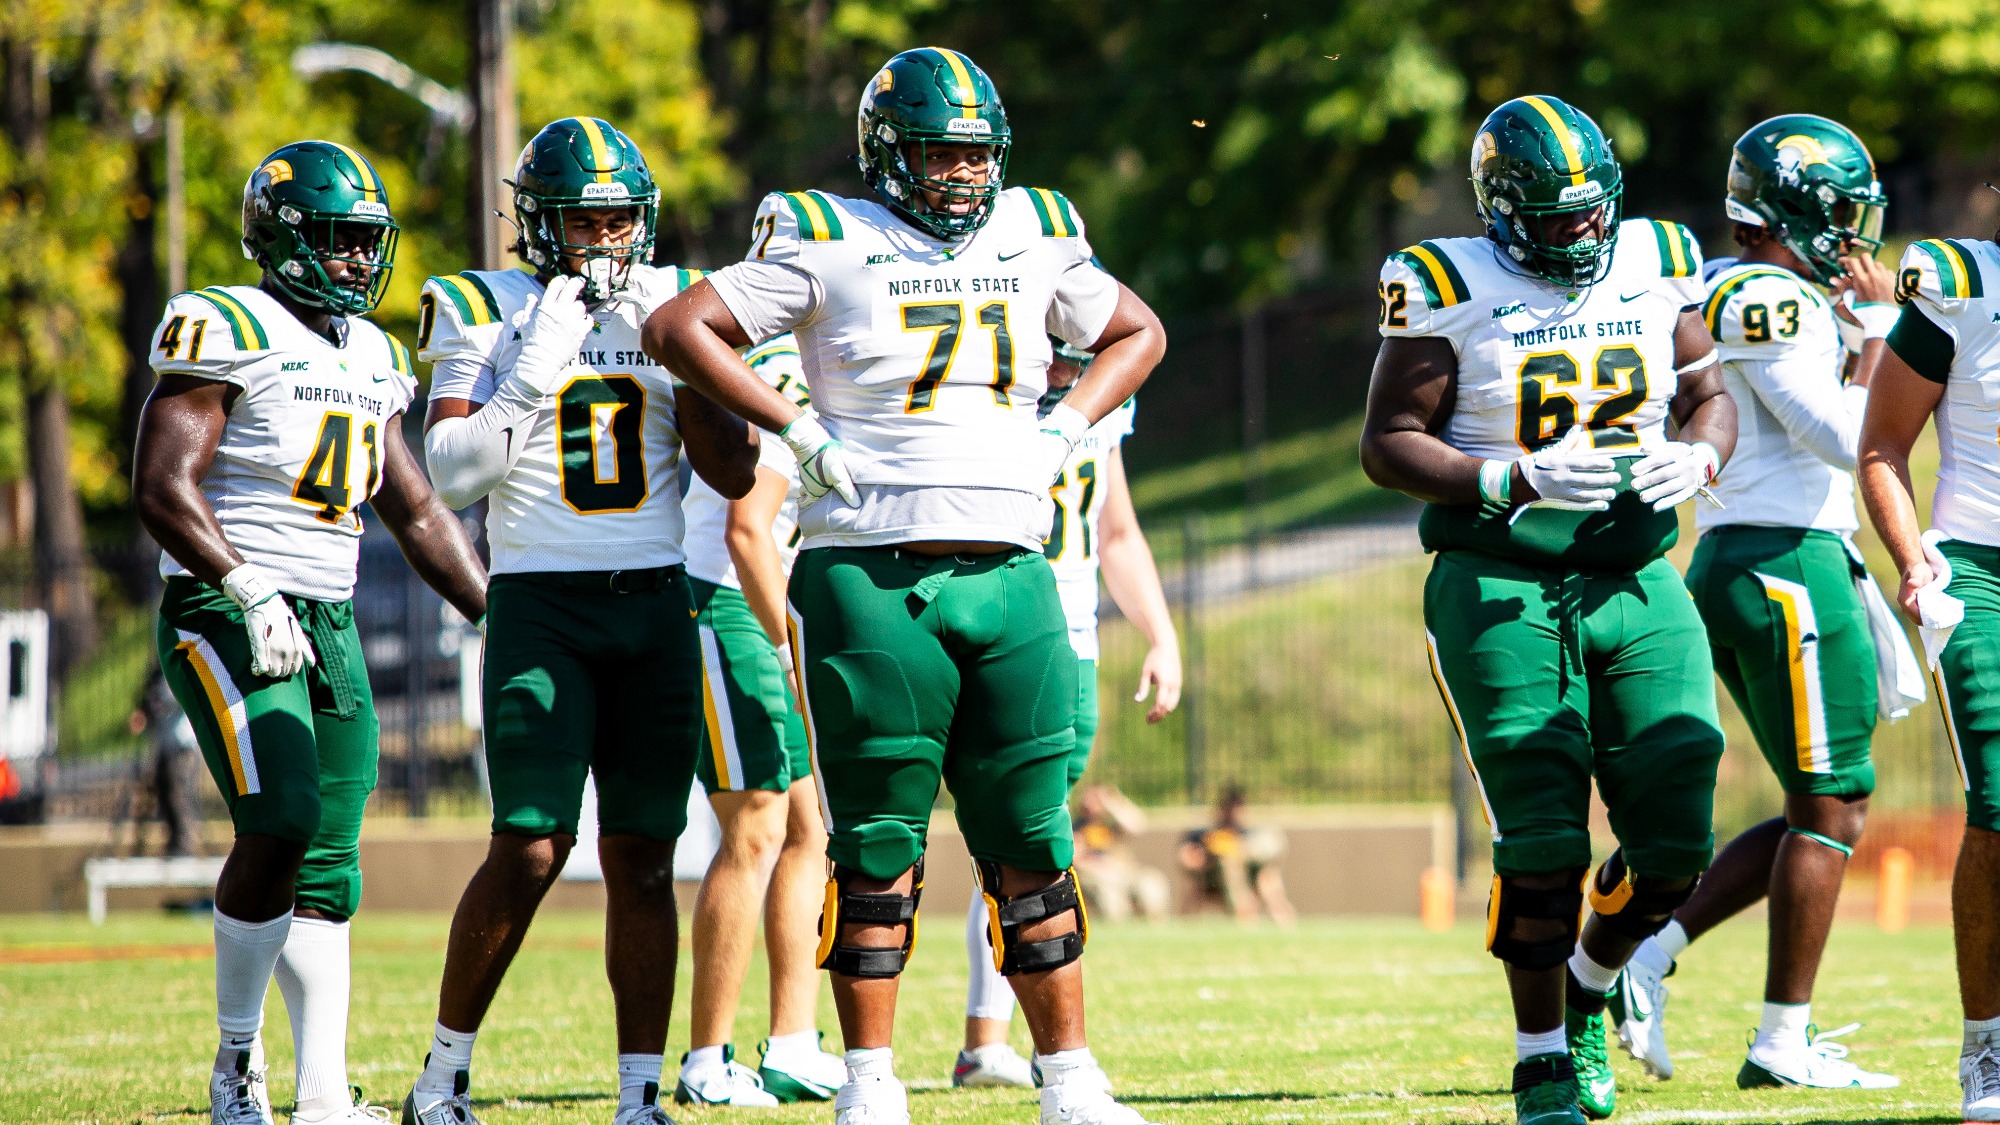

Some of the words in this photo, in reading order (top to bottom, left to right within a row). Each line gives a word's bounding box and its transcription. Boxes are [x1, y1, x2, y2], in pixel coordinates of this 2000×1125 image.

[952, 122, 986, 130] SPARTANS
[586, 186, 623, 195] SPARTANS
[1565, 185, 1598, 200] SPARTANS
[866, 254, 899, 266] MEAC
[889, 279, 962, 296] NORFOLK
[973, 278, 1020, 293] STATE
[1491, 303, 1526, 319] MEAC
[1742, 299, 1800, 343] 93
[157, 314, 208, 363] 41
[1512, 324, 1587, 348] NORFOLK
[1597, 320, 1643, 337] STATE
[280, 361, 309, 372] MEAC
[899, 299, 1016, 414] 71
[294, 386, 354, 405] NORFOLK
[358, 395, 382, 416] STATE
[1514, 343, 1650, 456] 62
[555, 373, 649, 516] 0
[290, 411, 379, 531] 41
